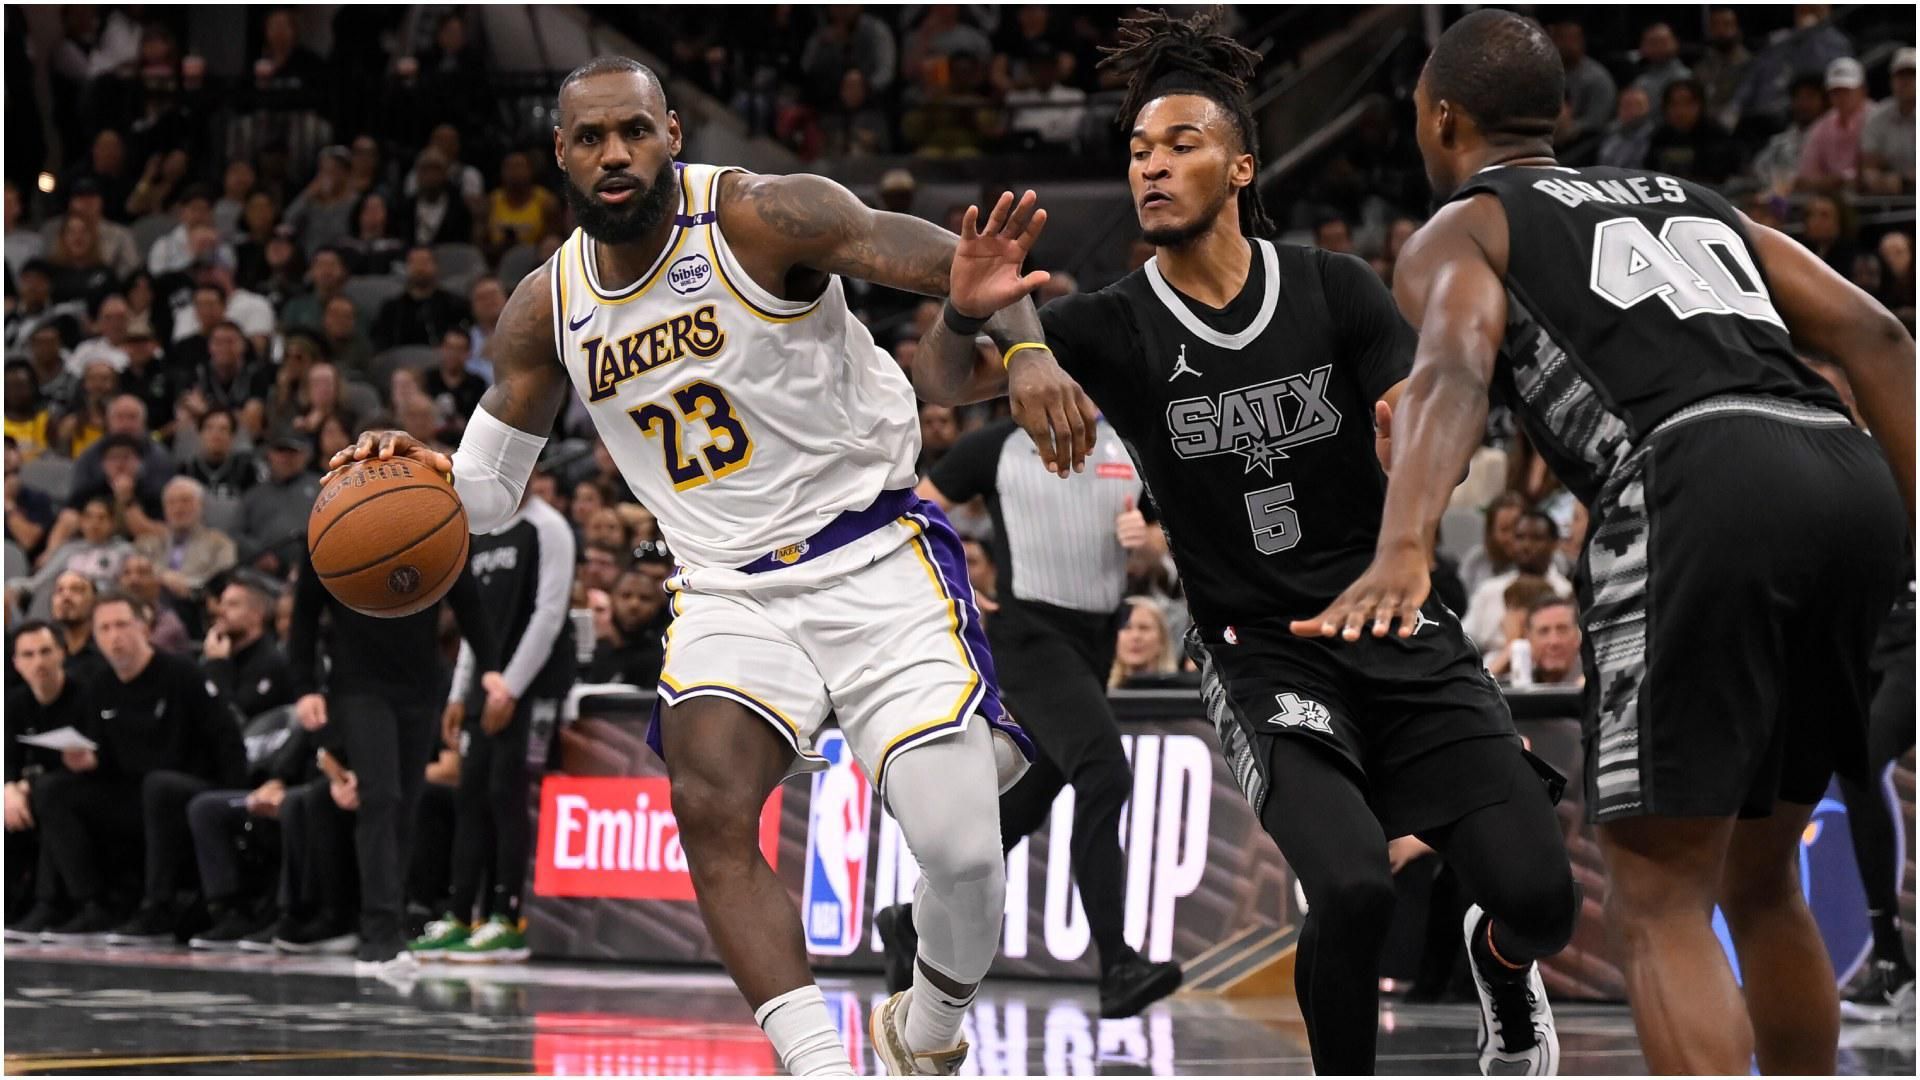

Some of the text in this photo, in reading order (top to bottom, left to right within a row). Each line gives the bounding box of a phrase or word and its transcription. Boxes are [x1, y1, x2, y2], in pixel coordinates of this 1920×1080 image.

[671, 264, 709, 283] bibigo
[1589, 216, 1790, 334] 40
[581, 304, 725, 402] LAKERS
[626, 379, 754, 492] 23
[1166, 364, 1342, 461] SATX
[1244, 482, 1301, 555] 5
[553, 792, 691, 873] Emira
